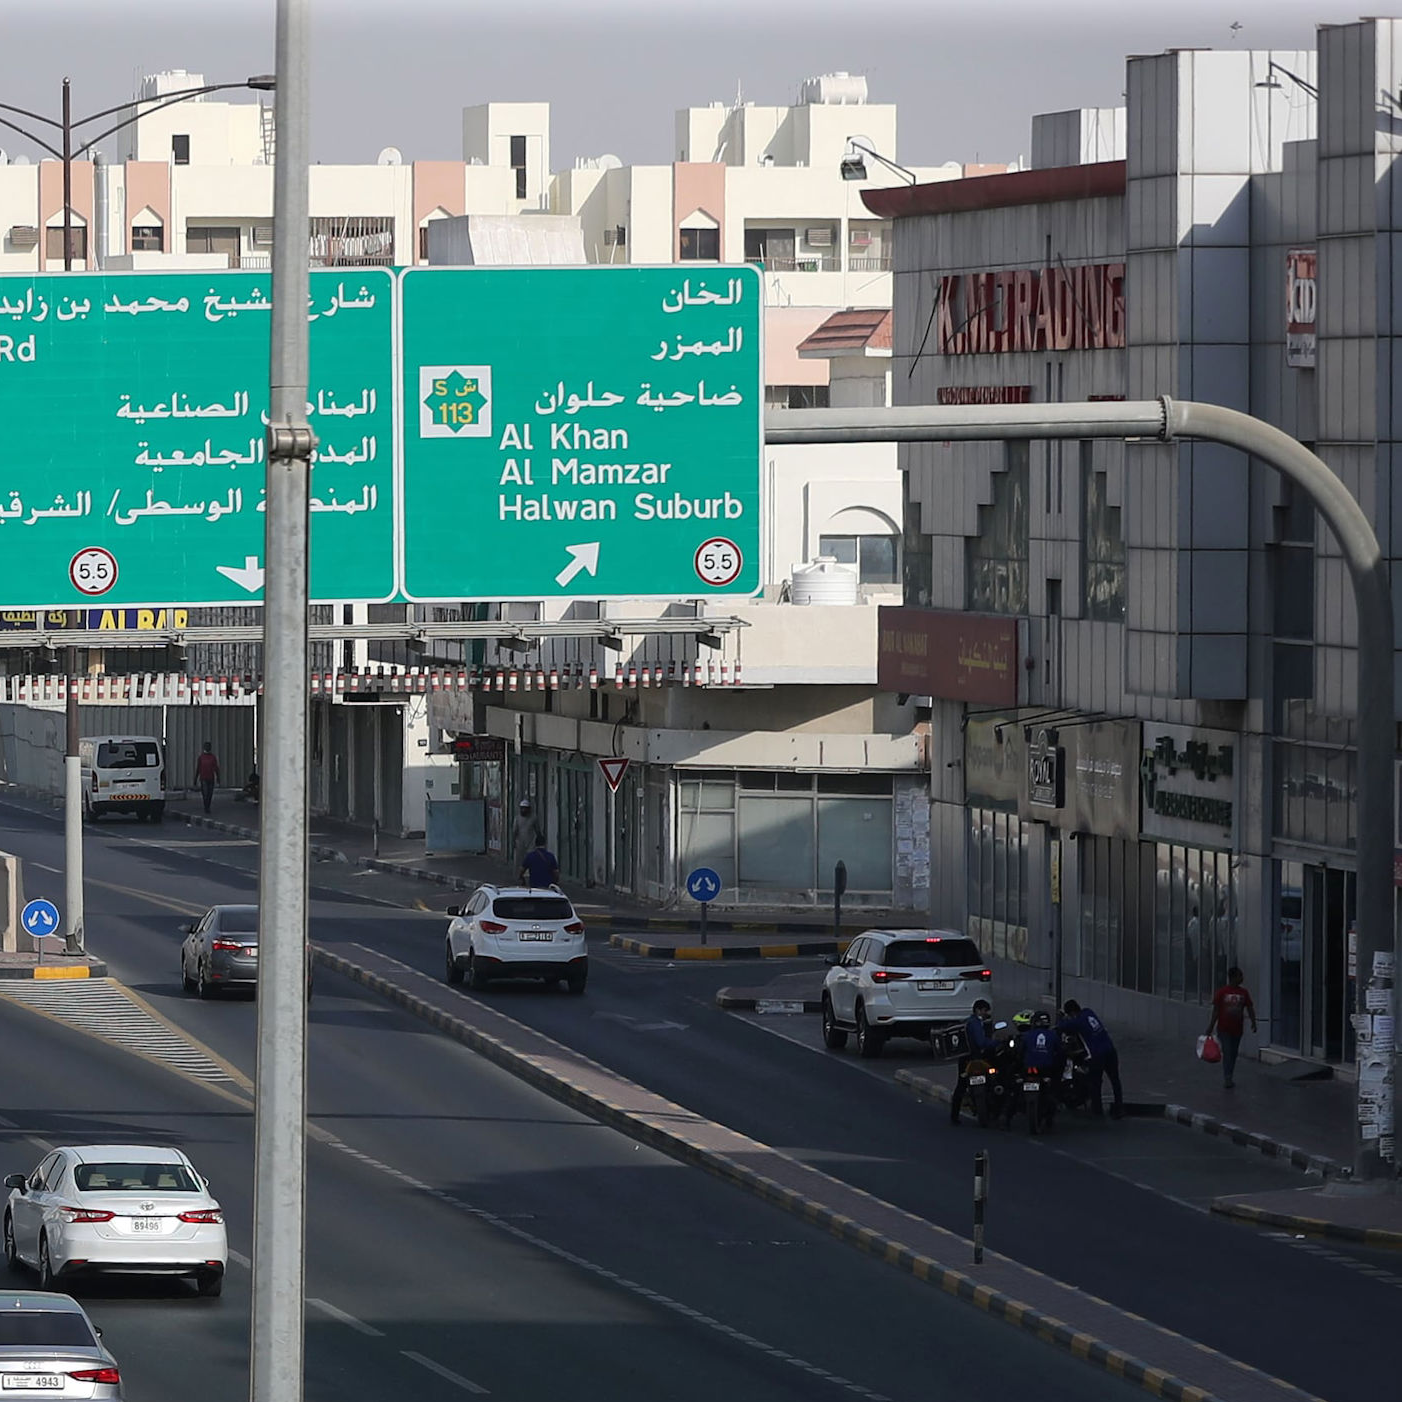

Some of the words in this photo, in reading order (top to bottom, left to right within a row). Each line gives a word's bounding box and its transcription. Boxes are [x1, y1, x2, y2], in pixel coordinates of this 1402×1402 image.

[56, 293, 92, 320] بن
[104, 292, 190, 316] محمد
[662, 277, 744, 313] الخان
[650, 326, 744, 361] الممزر
[116, 391, 249, 425] الصناعية
[534, 380, 626, 416] حلوان
[635, 380, 744, 412] ضاحية
[439, 402, 474, 424] 113
[499, 423, 535, 450] Al
[550, 422, 629, 450] Khan
[135, 438, 265, 473] الجامعية
[499, 458, 535, 486] Al
[551, 457, 672, 486] Mamzar
[498, 494, 618, 522] Halwan
[634, 492, 744, 521] Suburb
[78, 561, 109, 581] 5.5
[703, 553, 734, 571] 5.5
[35, 1376, 60, 1387] 4943
